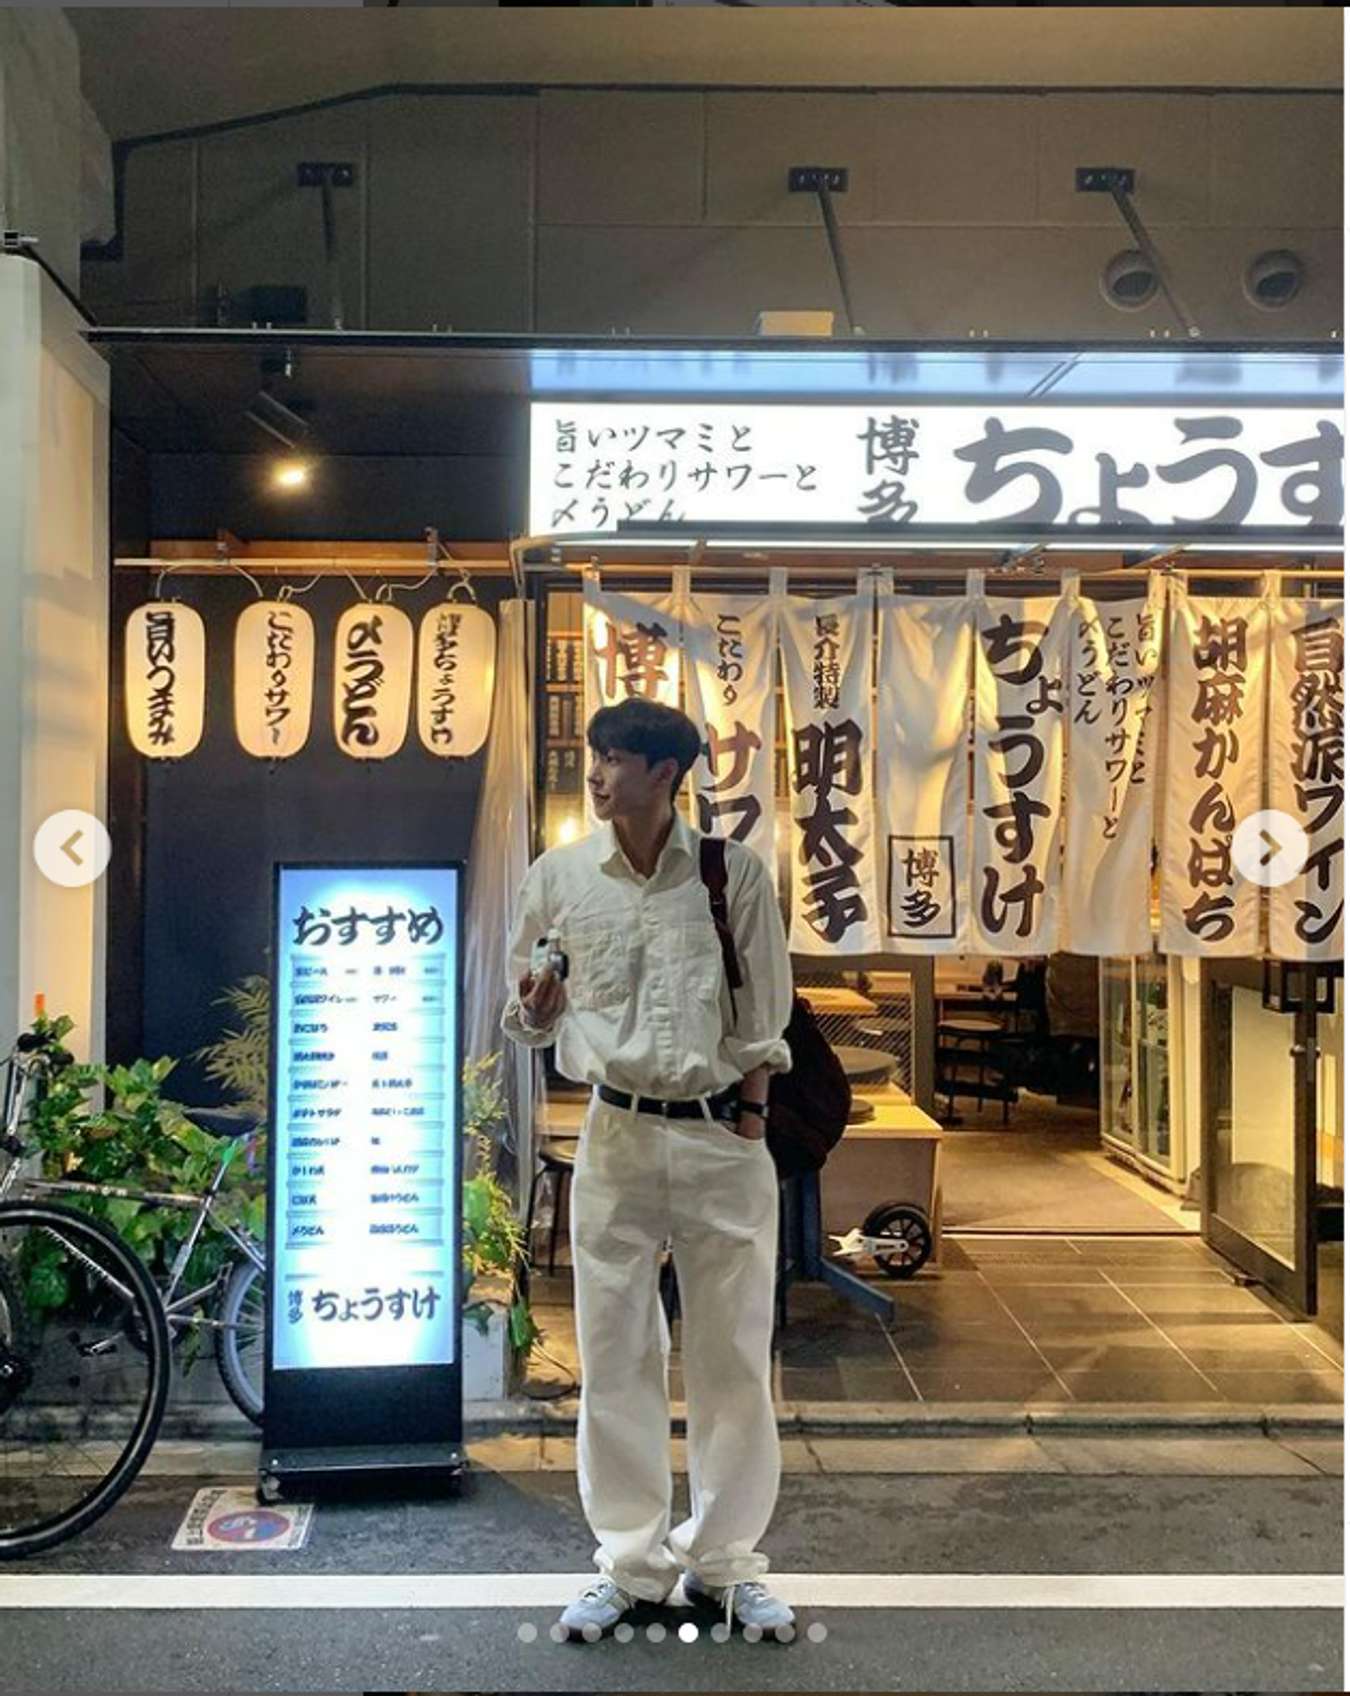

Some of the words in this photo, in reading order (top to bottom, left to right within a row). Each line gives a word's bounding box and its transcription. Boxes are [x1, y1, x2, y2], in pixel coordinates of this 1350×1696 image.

[554, 459, 817, 491] こだわりサワーと
[555, 419, 752, 453] 旨いツマミと
[857, 415, 920, 523] 博多
[953, 416, 1344, 524] ちょうす
[146, 611, 175, 746] 旨いつまみ
[1103, 617, 1133, 839] こだわりサワーと
[981, 615, 1065, 938] ちょうすけ
[1183, 615, 1249, 942] 胡麻かんぱち
[791, 719, 868, 943] 明太子
[292, 905, 444, 946] おすすめ
[901, 848, 940, 927] 博多
[311, 1286, 441, 1322] ちょうすけ
